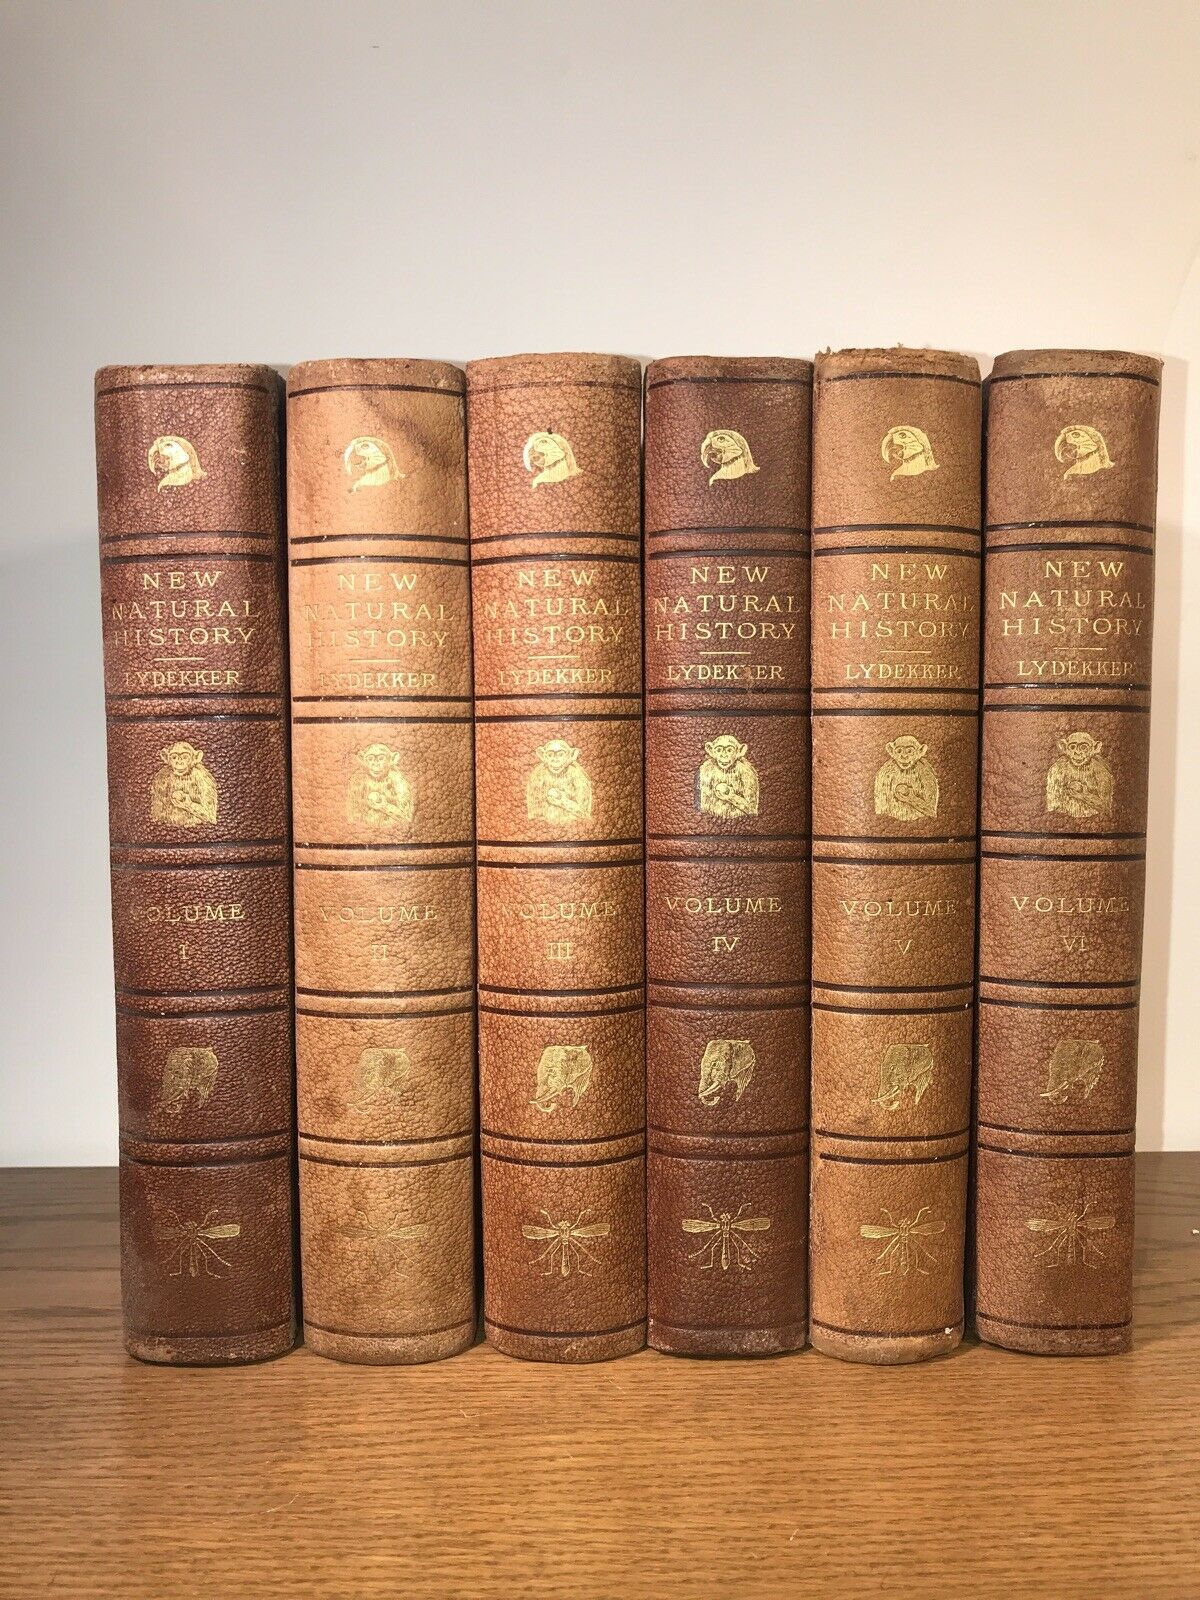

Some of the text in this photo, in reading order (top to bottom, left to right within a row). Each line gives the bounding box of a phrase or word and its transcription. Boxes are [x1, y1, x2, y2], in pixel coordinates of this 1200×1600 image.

[517, 569, 599, 588] NEW
[690, 566, 771, 584] NEW
[871, 563, 949, 581] NEW
[1044, 561, 1123, 578] NEW
[142, 571, 222, 590] NEW
[338, 573, 417, 592] NEW
[484, 598, 628, 619] NATURAL
[654, 595, 800, 614] NATURAL
[828, 592, 975, 613] NATURAL
[1000, 590, 1147, 610] NATURAL
[112, 600, 260, 620] NATURAL
[304, 602, 455, 621] NATURAL
[486, 625, 624, 646] HISTORY
[655, 622, 796, 641] HISTORY
[831, 621, 970, 639] HISTORY
[1002, 618, 1143, 636] HISTORY
[114, 627, 256, 646] HISTORY
[306, 629, 449, 648] HISTORY
[499, 668, 615, 685] LYDEKKER
[844, 664, 961, 680] LYDEKKER
[1017, 660, 1138, 676] LYDEKKER
[124, 670, 242, 687] LYDEKKER
[319, 672, 437, 688] LYDEKKER
[665, 897, 782, 913] VOLUME
[840, 900, 959, 916] VOLUME
[1010, 897, 1130, 913] VOLUME
[179, 943, 190, 960] I
[371, 944, 389, 961] II
[547, 942, 573, 960] III
[712, 936, 740, 952] IV
[893, 939, 913, 956] V
[1060, 935, 1088, 952] VI
